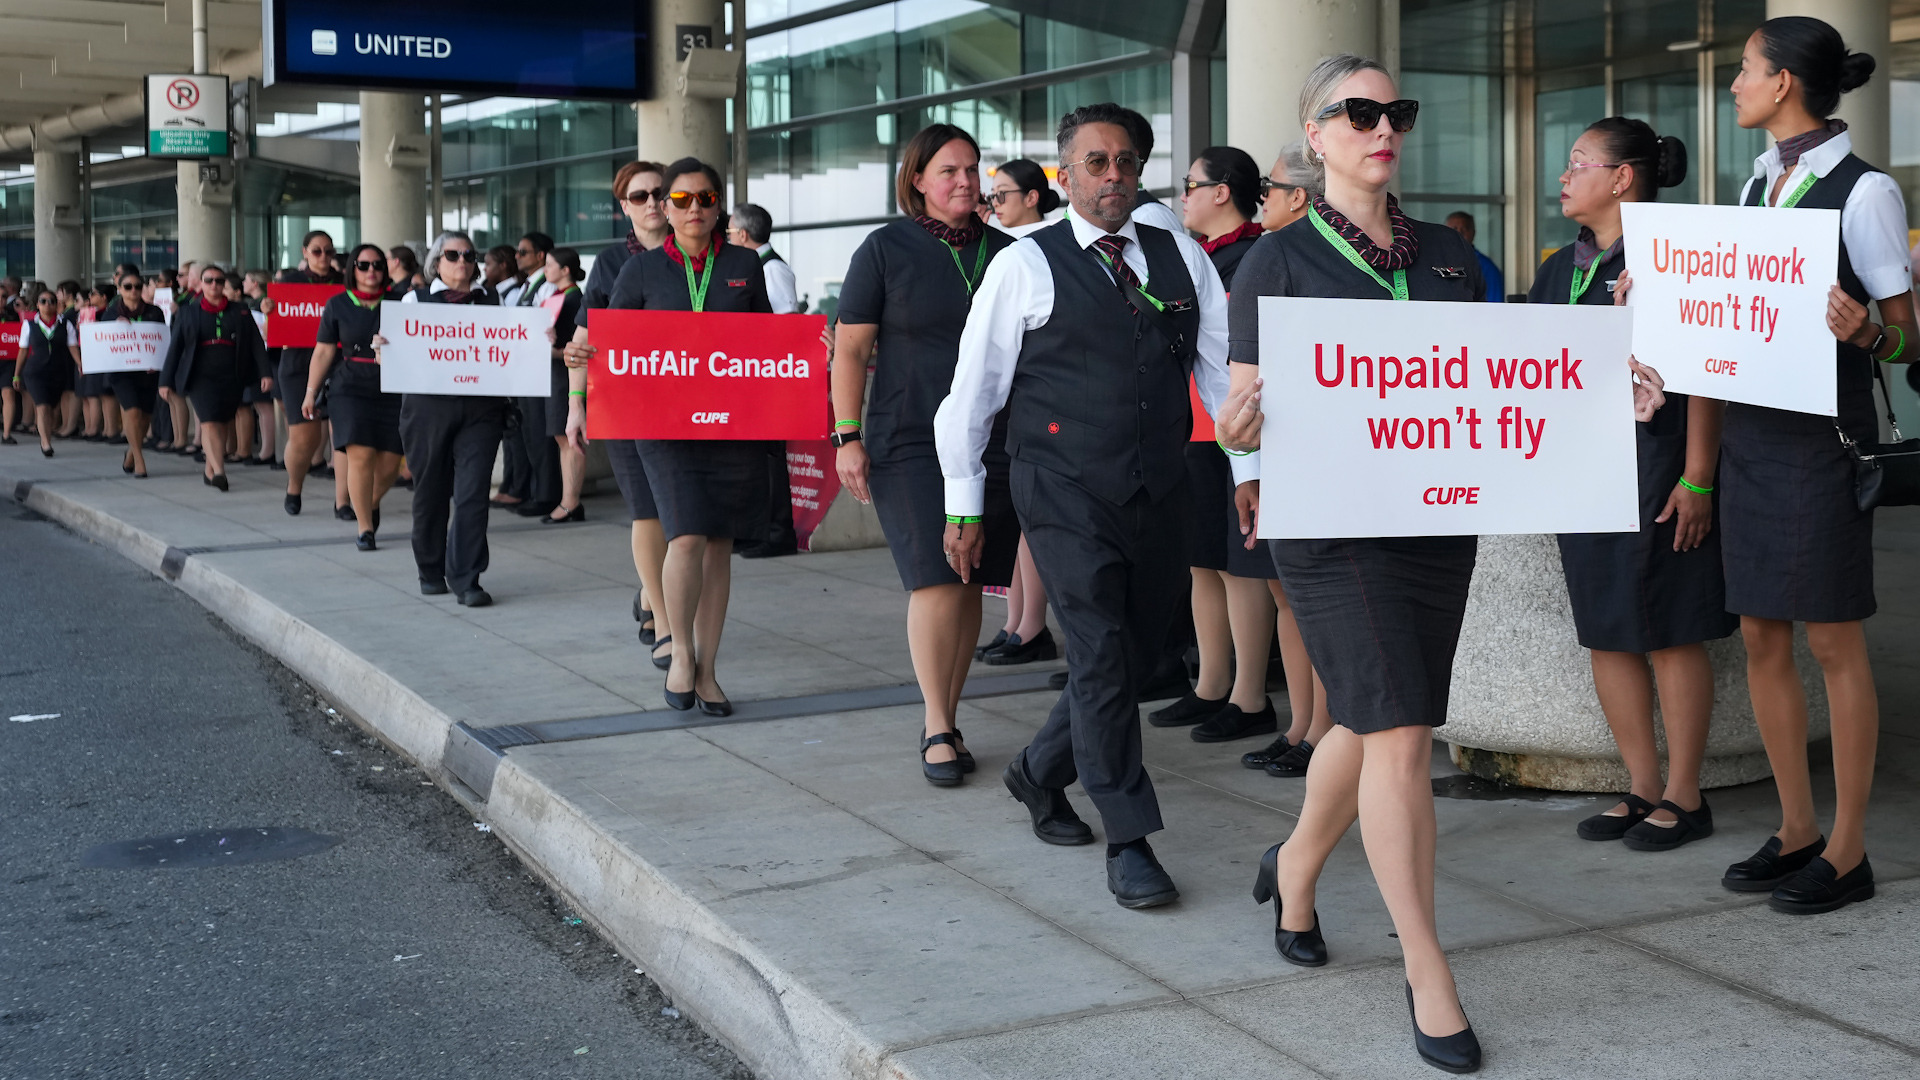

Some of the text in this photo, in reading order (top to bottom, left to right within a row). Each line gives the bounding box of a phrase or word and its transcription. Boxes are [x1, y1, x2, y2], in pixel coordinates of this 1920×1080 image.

[354, 32, 452, 59] UNITED
[1654, 238, 1738, 284] Unpaid
[1747, 246, 1806, 285] work
[277, 301, 325, 318] UnfAir
[1679, 293, 1780, 343] won't fly
[1, 332, 19, 344] Can
[94, 330, 163, 343] Unpaid work
[405, 319, 528, 342] Unpaid work
[109, 342, 156, 355] won't fly
[428, 345, 511, 367] won't fly
[608, 349, 810, 379] UnfAir Canada
[1314, 343, 1584, 399] Unpaid work
[1705, 358, 1738, 376] CUPE
[453, 375, 480, 384] CUPE
[691, 411, 730, 424] CUPE
[1367, 405, 1546, 460] won't fly
[1422, 486, 1480, 506] CUPE
